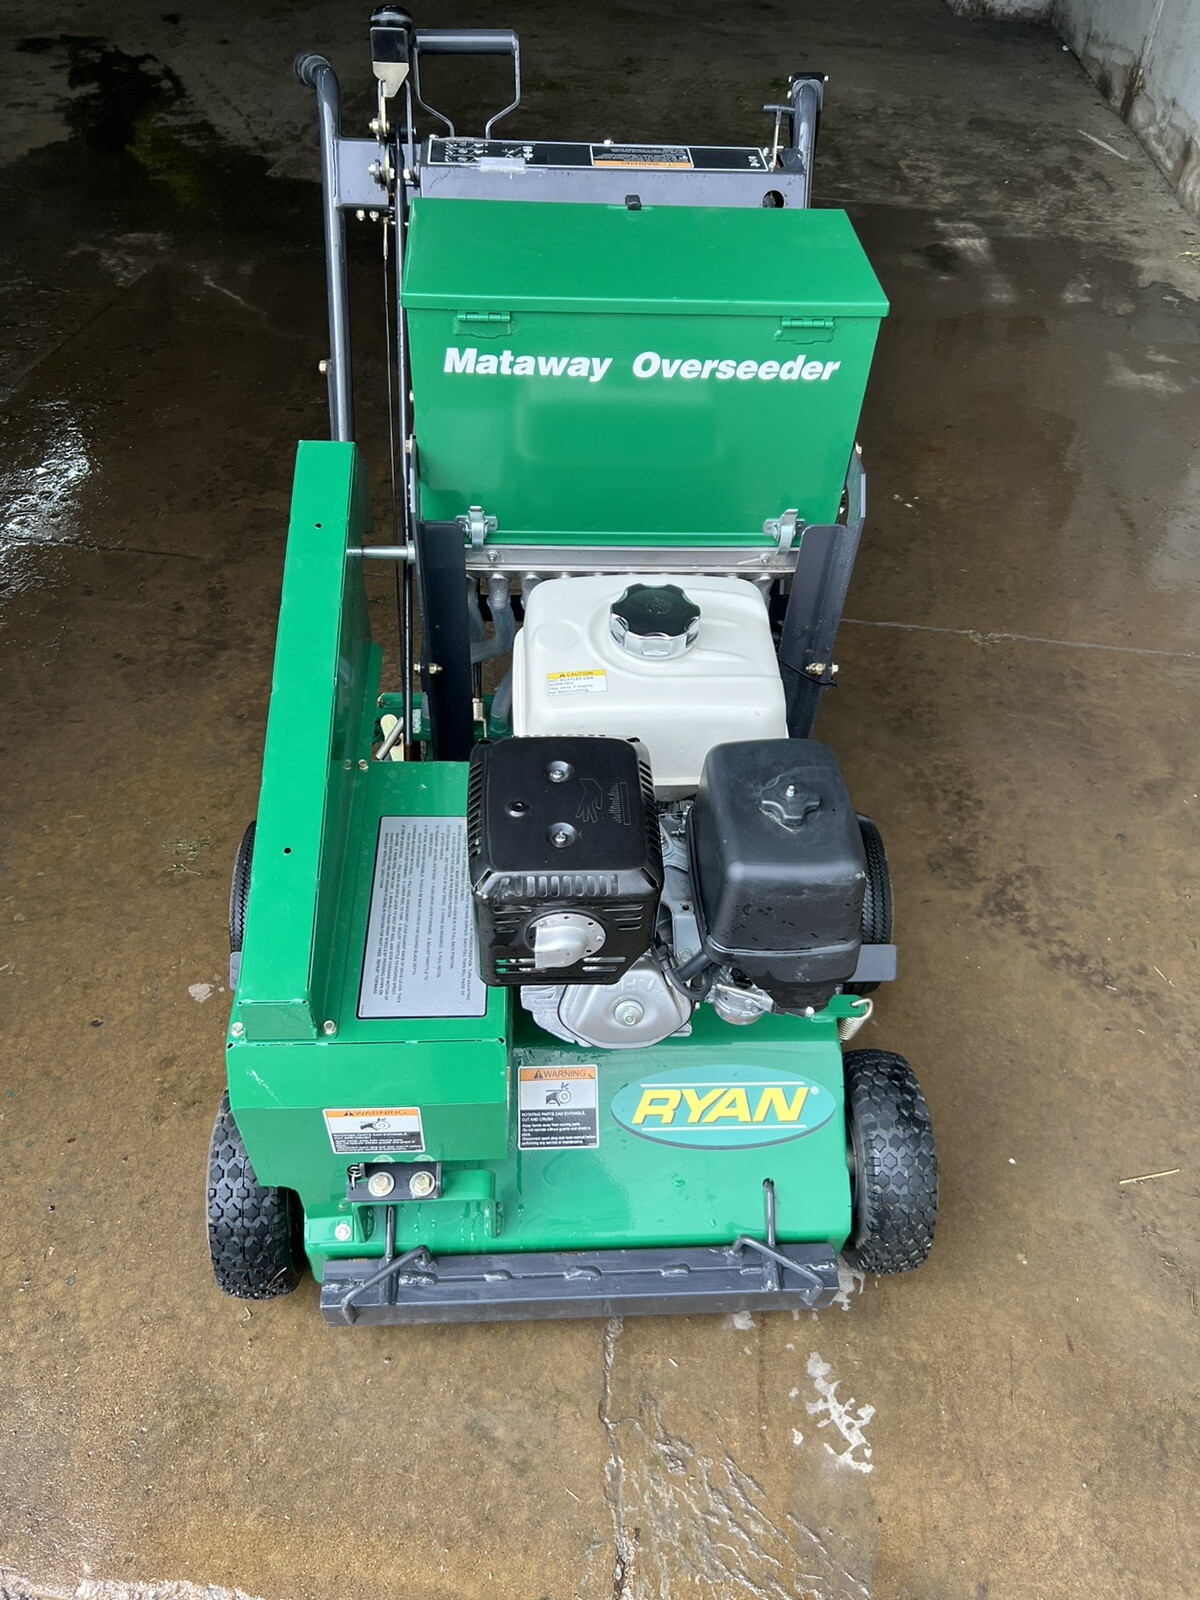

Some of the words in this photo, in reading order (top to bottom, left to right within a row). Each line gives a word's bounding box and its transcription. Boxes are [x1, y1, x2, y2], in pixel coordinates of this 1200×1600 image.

[444, 348, 612, 382] Mataway
[633, 352, 841, 381] Overseeder
[544, 1070, 586, 1078] WARNING
[632, 1087, 809, 1124] RYAN
